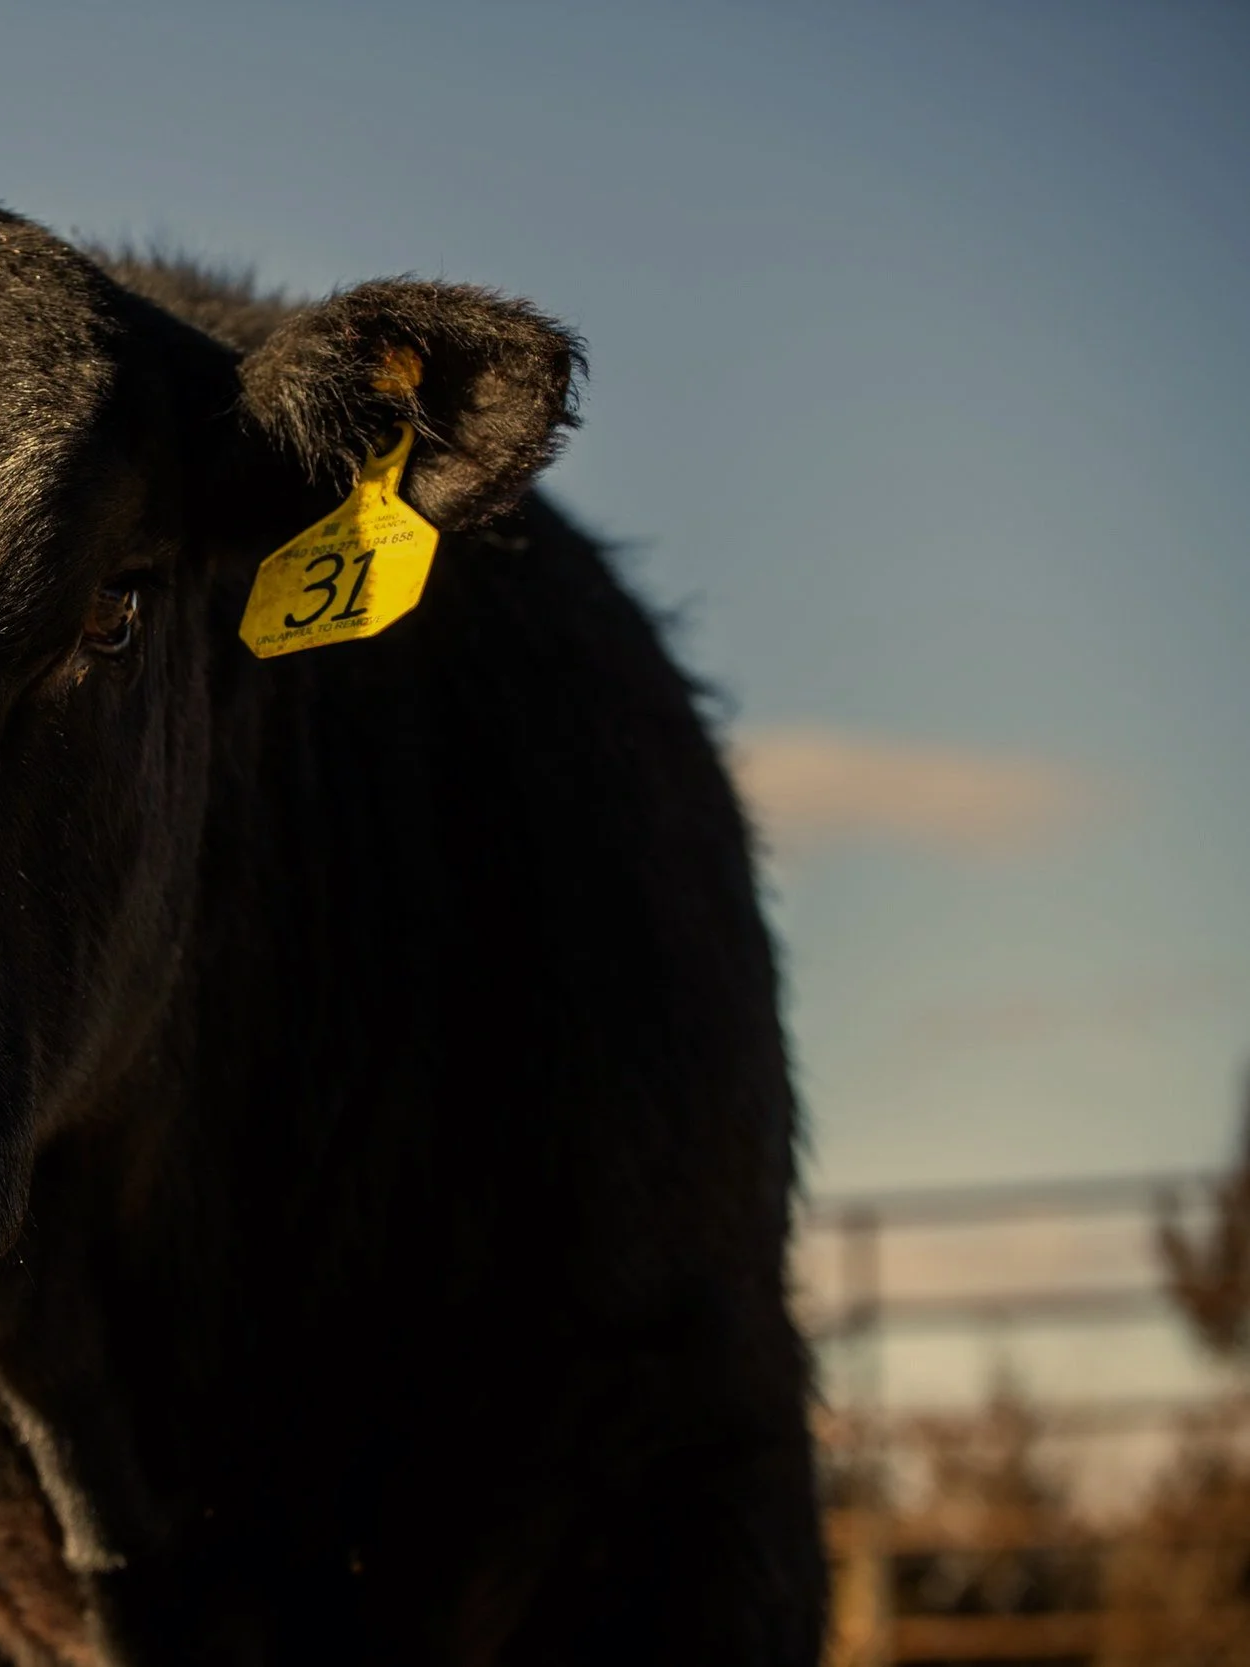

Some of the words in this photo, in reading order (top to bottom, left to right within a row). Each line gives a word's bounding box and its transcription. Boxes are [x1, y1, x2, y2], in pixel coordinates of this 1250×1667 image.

[391, 530, 415, 545] 658
[284, 549, 377, 628] 31
[317, 621, 334, 633] TO
